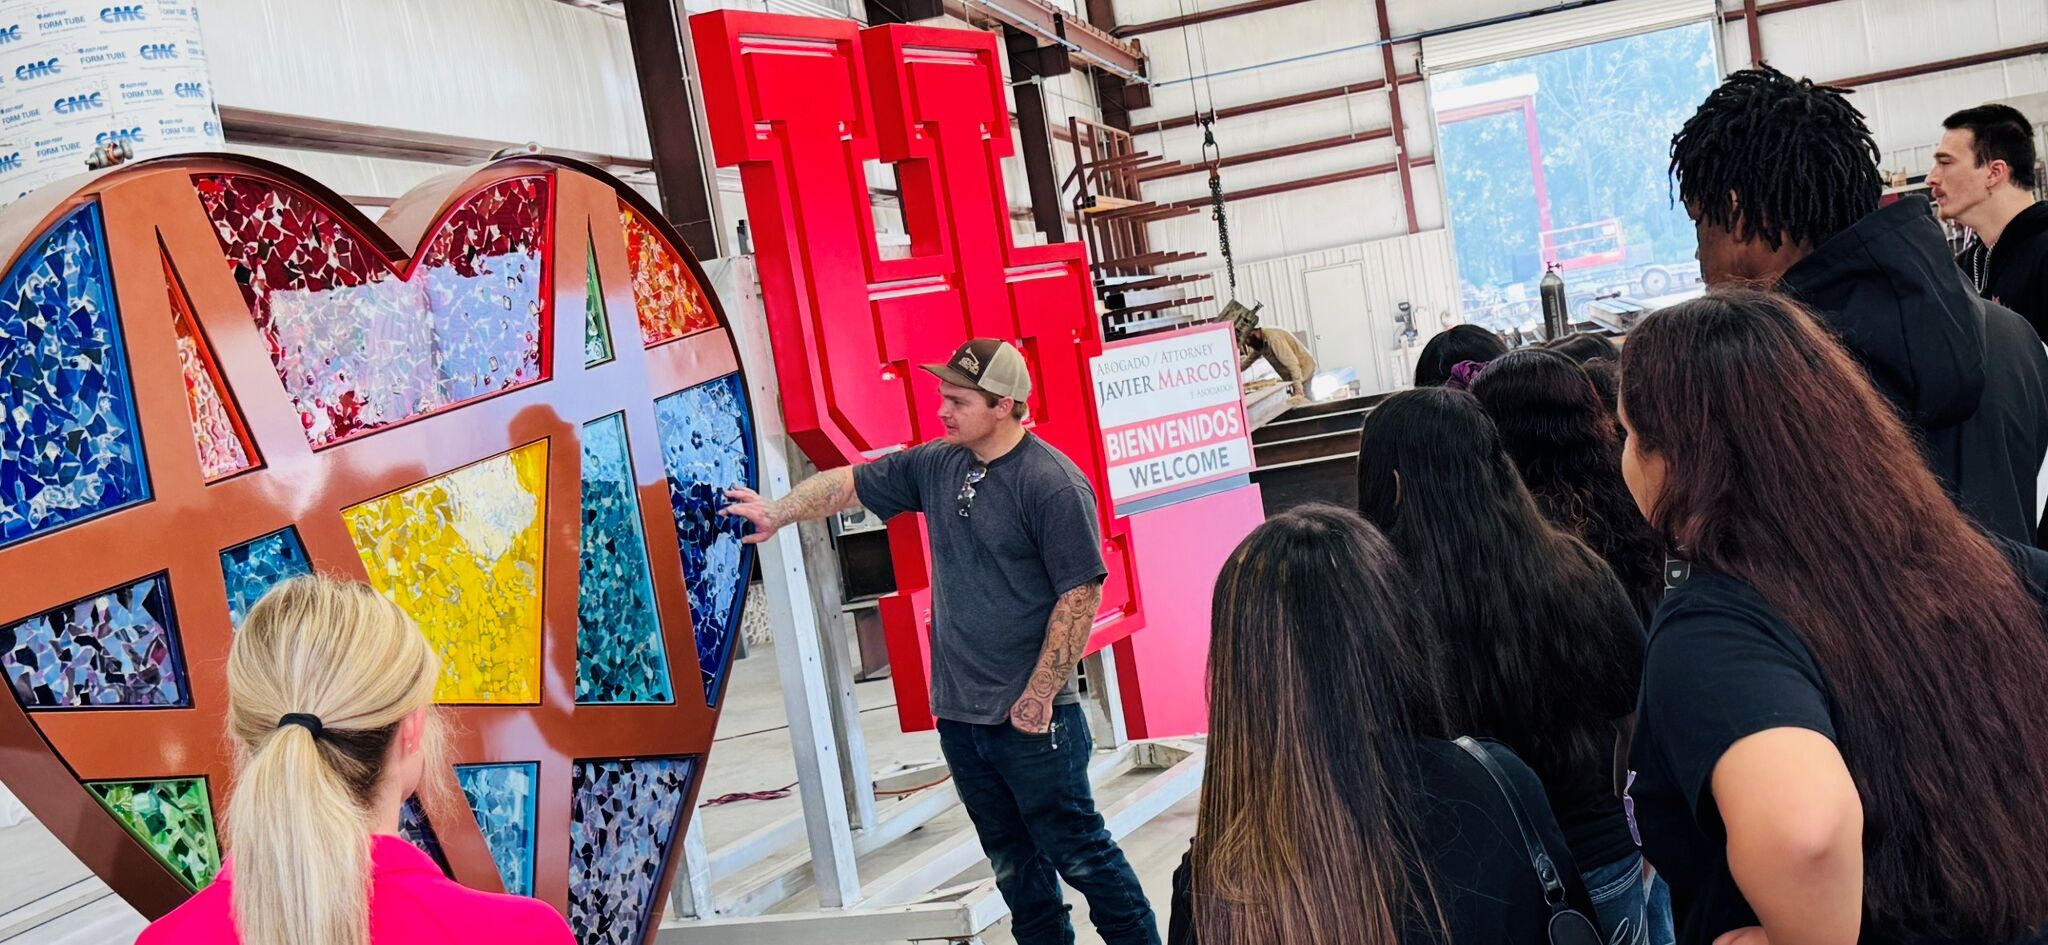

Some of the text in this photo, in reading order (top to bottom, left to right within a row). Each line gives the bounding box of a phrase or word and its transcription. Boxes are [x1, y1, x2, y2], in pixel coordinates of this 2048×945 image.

[38, 15, 86, 31] FORM TUBE
[100, 4, 146, 24] CMC
[80, 51, 126, 65] FORM TUBE
[140, 43, 179, 61] CMC
[16, 57, 61, 82] CMC
[53, 91, 104, 115] CMC
[121, 88, 165, 99] FORM TUBE
[1, 114, 21, 125] FORM
[21, 108, 41, 119] TUBE
[36, 147, 59, 158] FORM
[60, 141, 81, 152] TUBE
[1096, 355, 1150, 376] ABOGADO
[1160, 343, 1214, 364] ATTORNEY
[1098, 360, 1232, 408] JAVIER MARCOS
[1106, 407, 1239, 461] BIENVENIDOS
[1129, 447, 1230, 488] WELCOME
